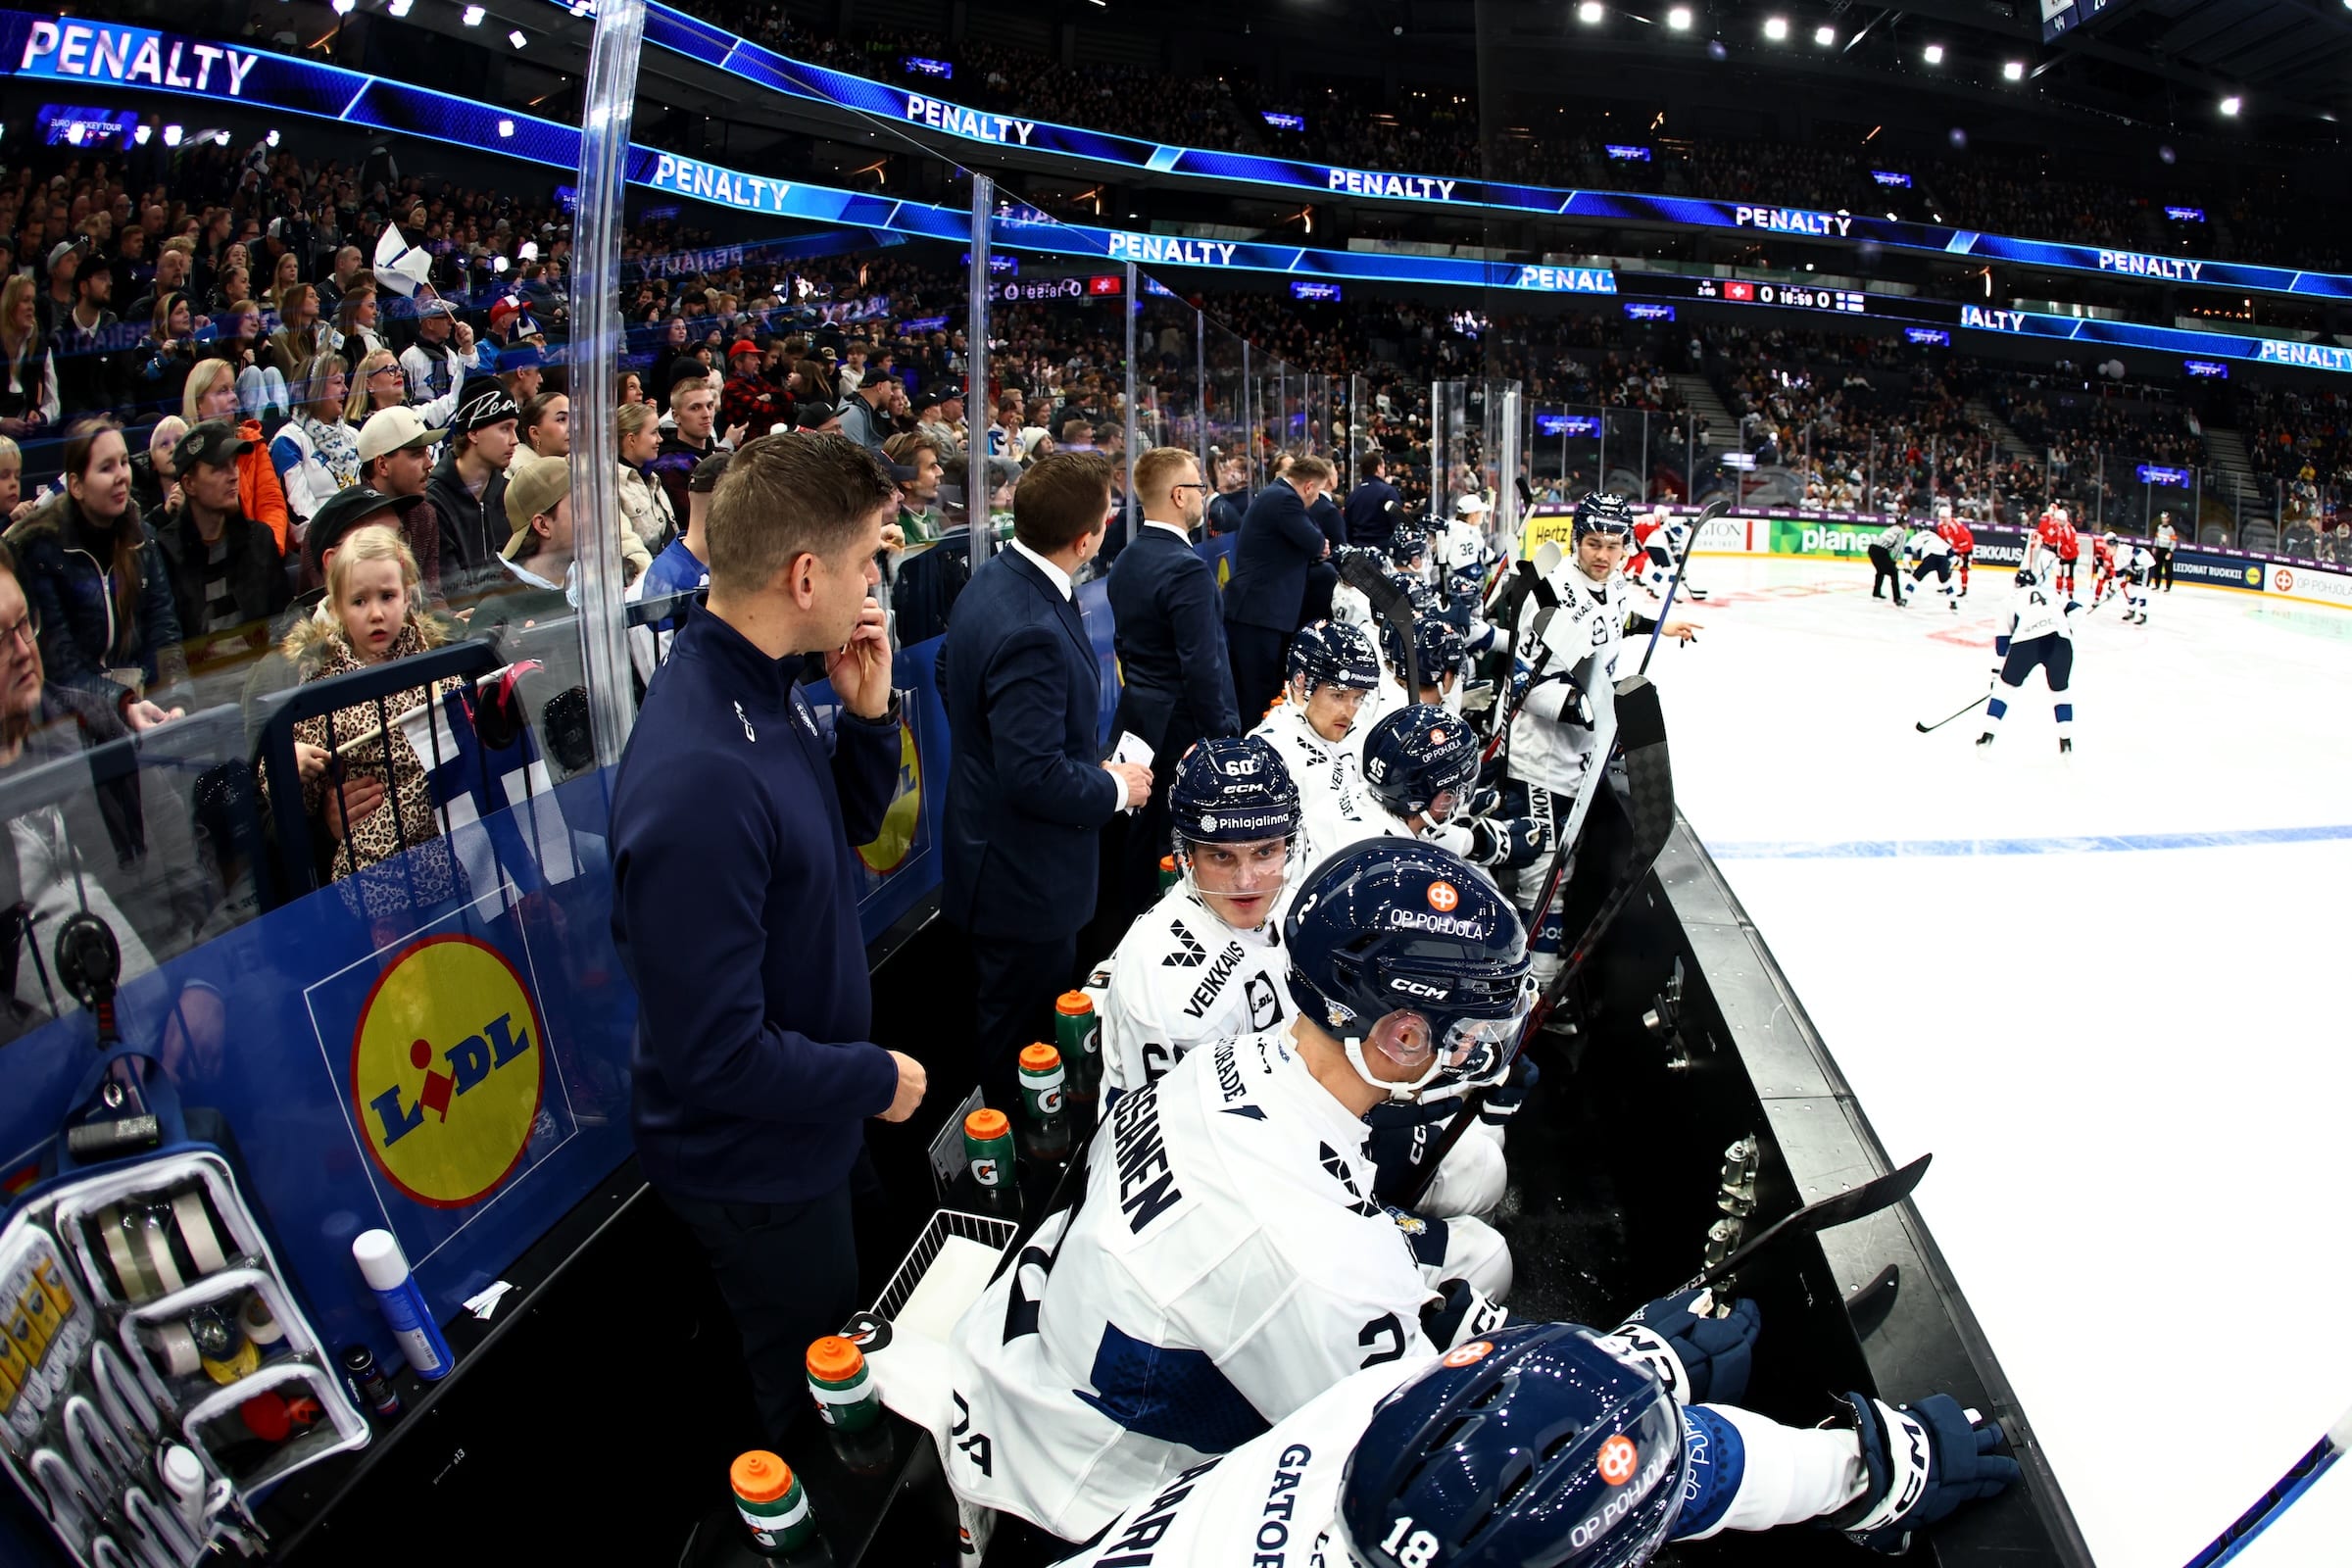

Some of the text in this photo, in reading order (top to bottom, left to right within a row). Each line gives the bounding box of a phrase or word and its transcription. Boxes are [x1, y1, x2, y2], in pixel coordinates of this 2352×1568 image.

[22, 21, 259, 95] PENALTY
[906, 95, 1034, 145] PENALTY
[656, 155, 790, 211] PENALTY
[1329, 169, 1455, 200] PENALTY
[1737, 207, 1851, 237] PENALTY
[1109, 232, 1236, 266] PENALTY
[2099, 252, 2202, 280] PENALTY
[1760, 286, 1774, 303] 0
[1780, 291, 1813, 307] 18:59
[1817, 292, 1831, 308] 0
[1459, 542, 1474, 556] 32
[1536, 525, 1568, 545] Hertz
[2173, 562, 2243, 580] LEIJONAT RUOKKII
[1422, 740, 1462, 763] OP POHJOLA
[1225, 759, 1255, 777] 60
[1369, 756, 1387, 779] 45
[1436, 773, 1460, 787] CCM
[1223, 783, 1263, 795] CCM
[1219, 812, 1290, 830] Pihlajalinna
[1390, 908, 1484, 941] OP POHJOLA
[1184, 940, 1246, 1019] VEIKKAUS
[1390, 977, 1448, 1001] CCM
[1037, 1085, 1063, 1114] G
[970, 1158, 1000, 1186] G
[1113, 1080, 1183, 1236] SSANEN
[1570, 1446, 1672, 1548] OP POHJOLA
[1380, 1516, 1440, 1568] 18
